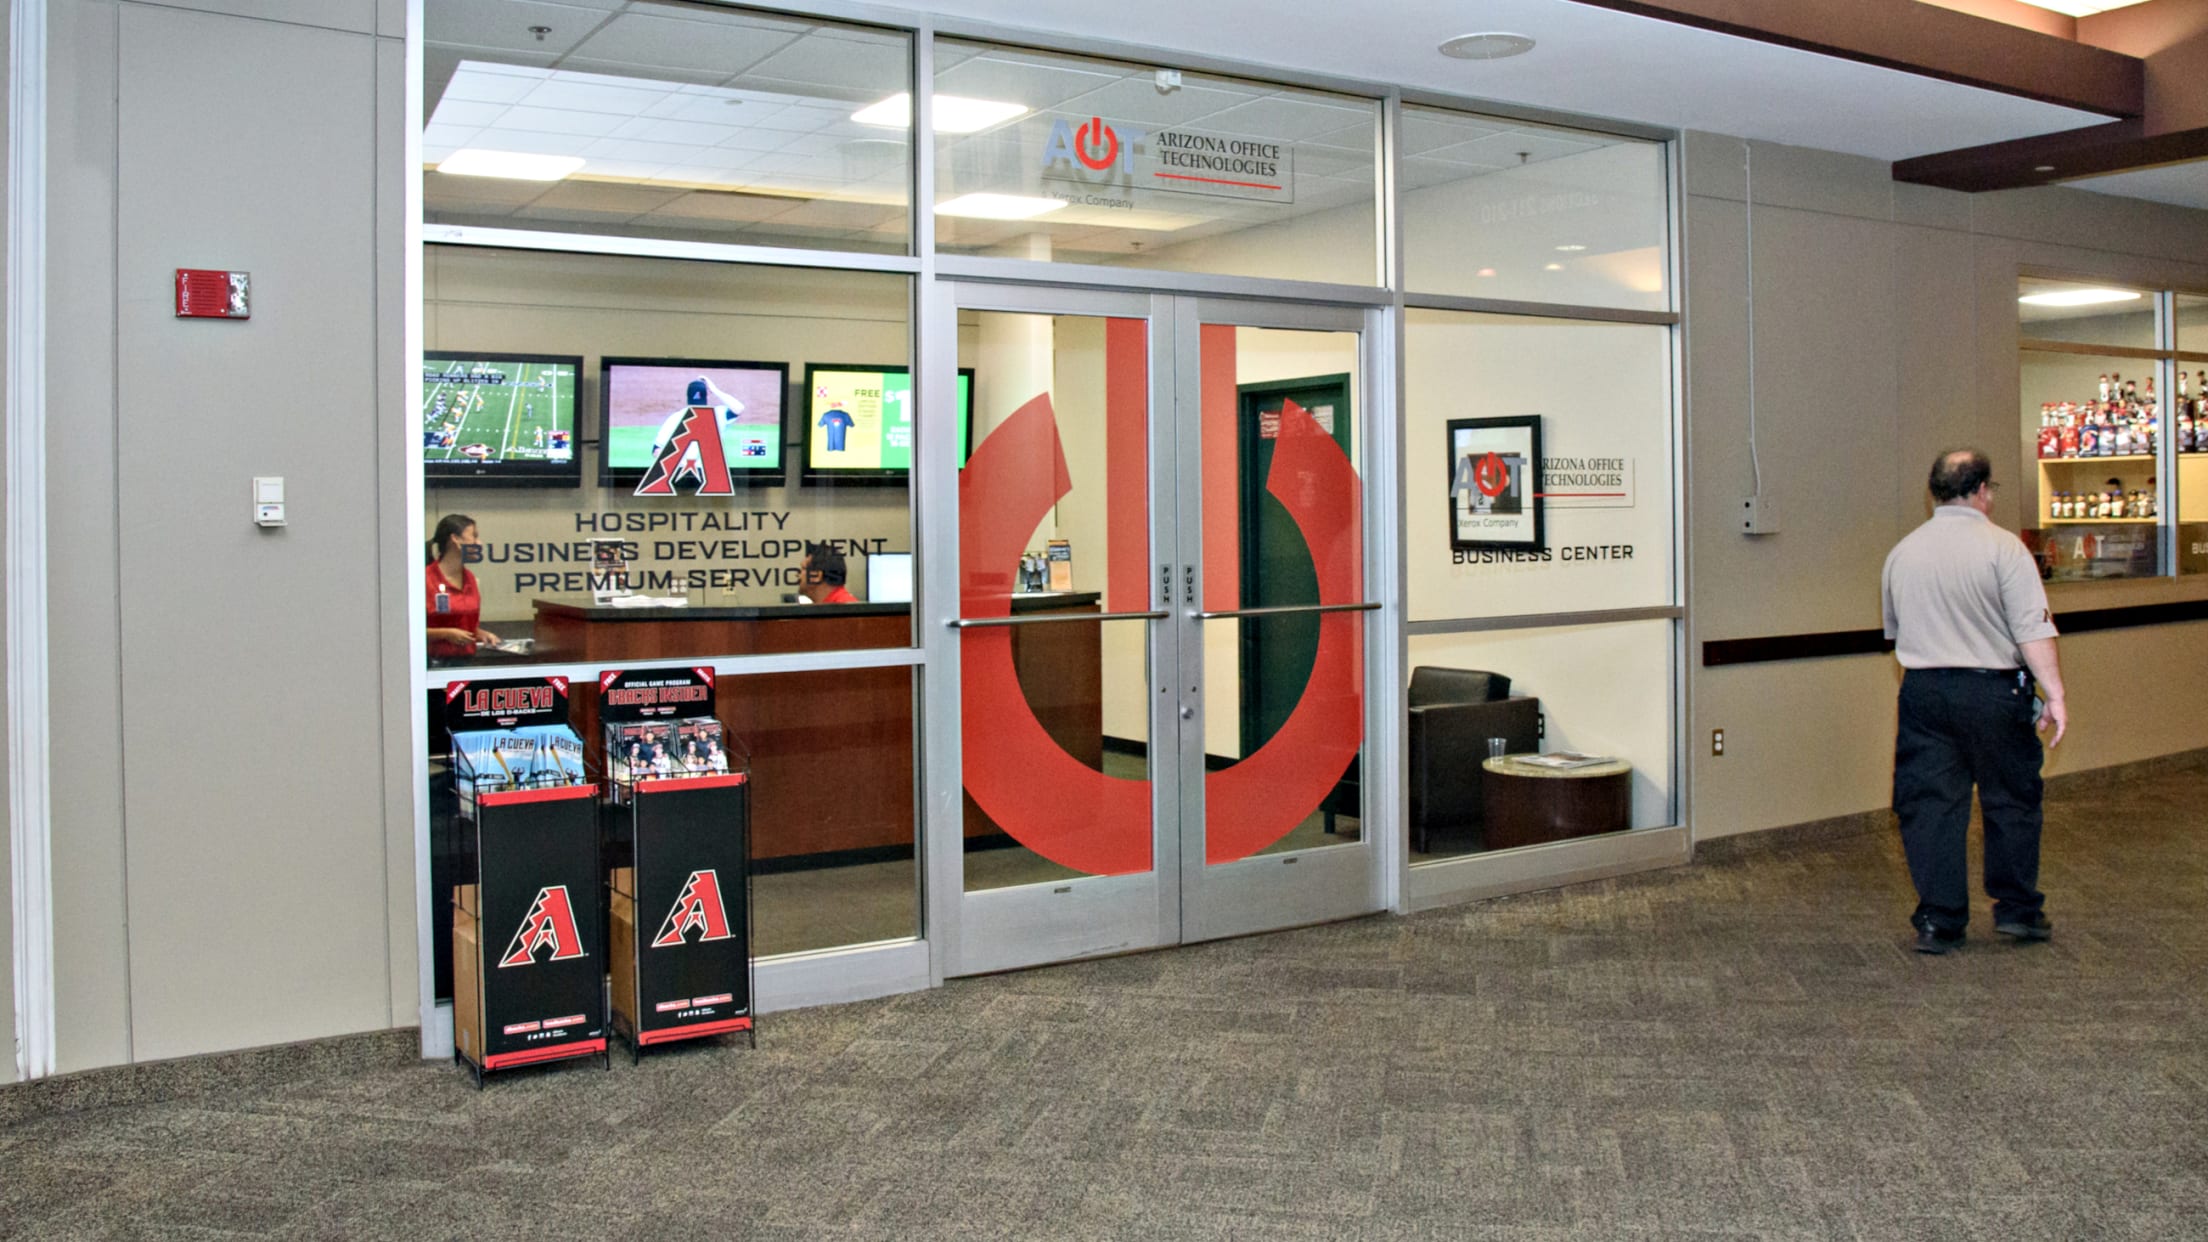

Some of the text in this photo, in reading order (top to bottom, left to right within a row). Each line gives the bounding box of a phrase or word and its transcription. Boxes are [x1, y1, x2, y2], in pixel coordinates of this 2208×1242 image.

[1155, 131, 1280, 160] ARIZONA OFFICE
[1160, 150, 1278, 178] TECHNOLOGIES
[1085, 194, 1135, 210] Company
[855, 389, 881, 398] FREE
[1543, 457, 1625, 471] RIZONA OFFICE
[1543, 473, 1623, 487] ECHNOLOGIES
[576, 511, 790, 533] HOSPITALITY
[1483, 518, 1519, 530] Company
[461, 541, 640, 564] BUSINESS
[654, 538, 888, 561] DEVELOPMENT
[1452, 545, 1634, 564] BUSINESS CENTER
[514, 570, 675, 594] PREMIUM
[464, 686, 553, 712] LA CUEVA
[507, 738, 535, 750] CUEVA
